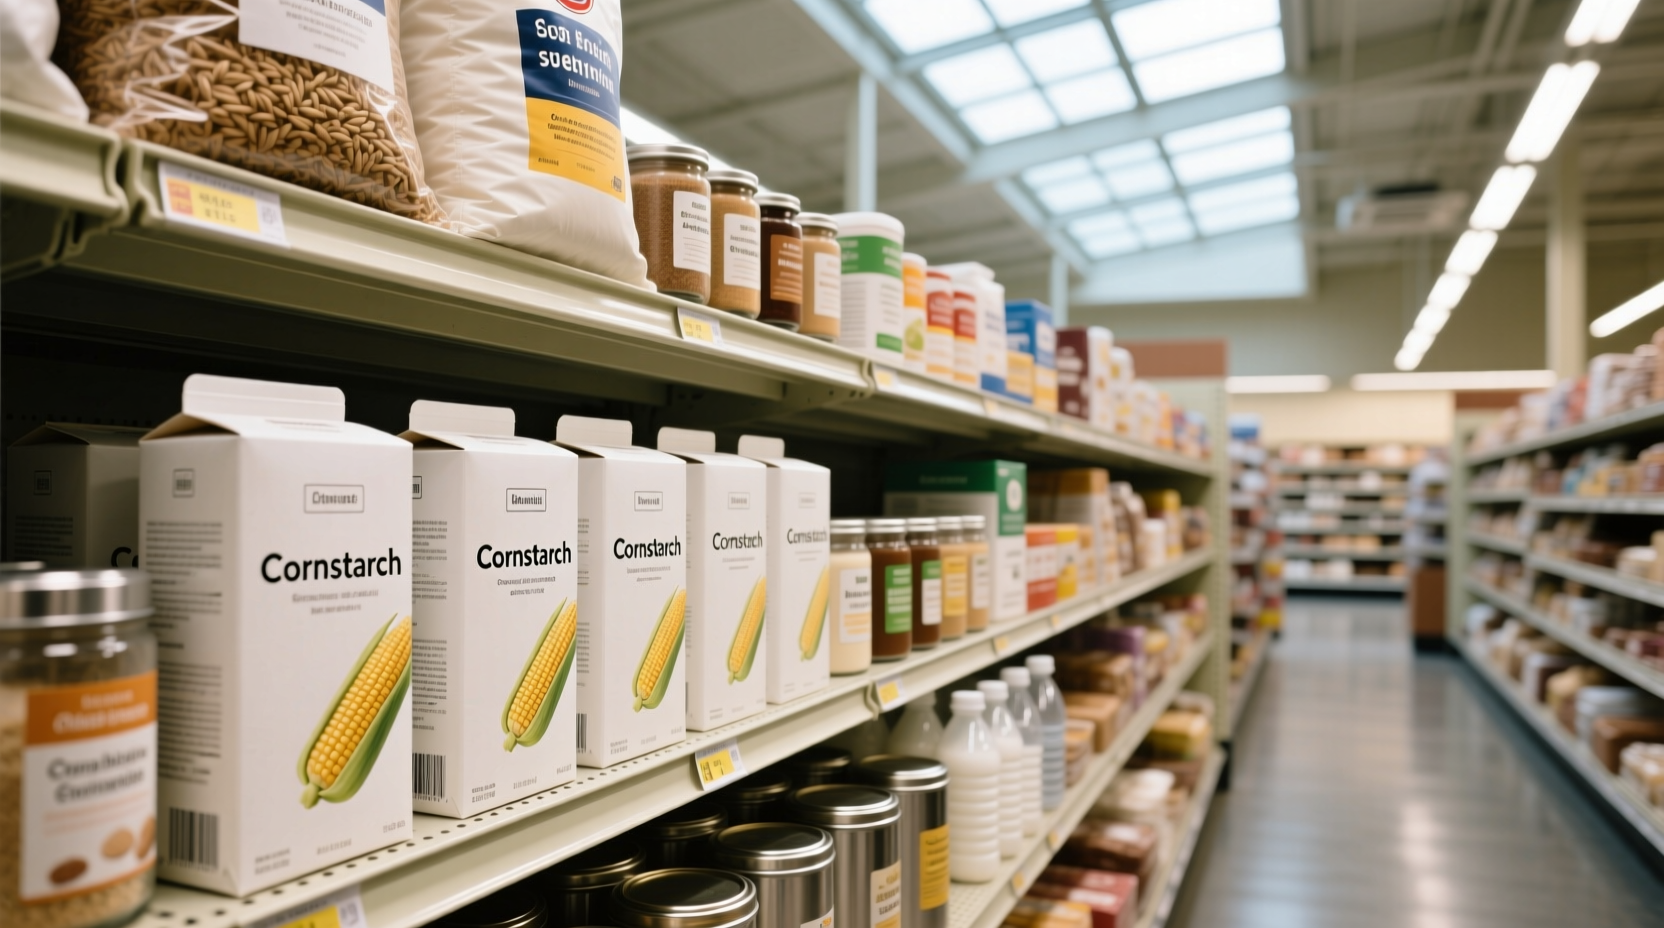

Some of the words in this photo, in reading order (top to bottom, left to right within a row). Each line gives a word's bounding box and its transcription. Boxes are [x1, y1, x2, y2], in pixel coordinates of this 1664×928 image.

[476, 541, 572, 569] Cornstarch
[613, 535, 681, 560] Cornstarch
[261, 547, 402, 583] Cornstarch
